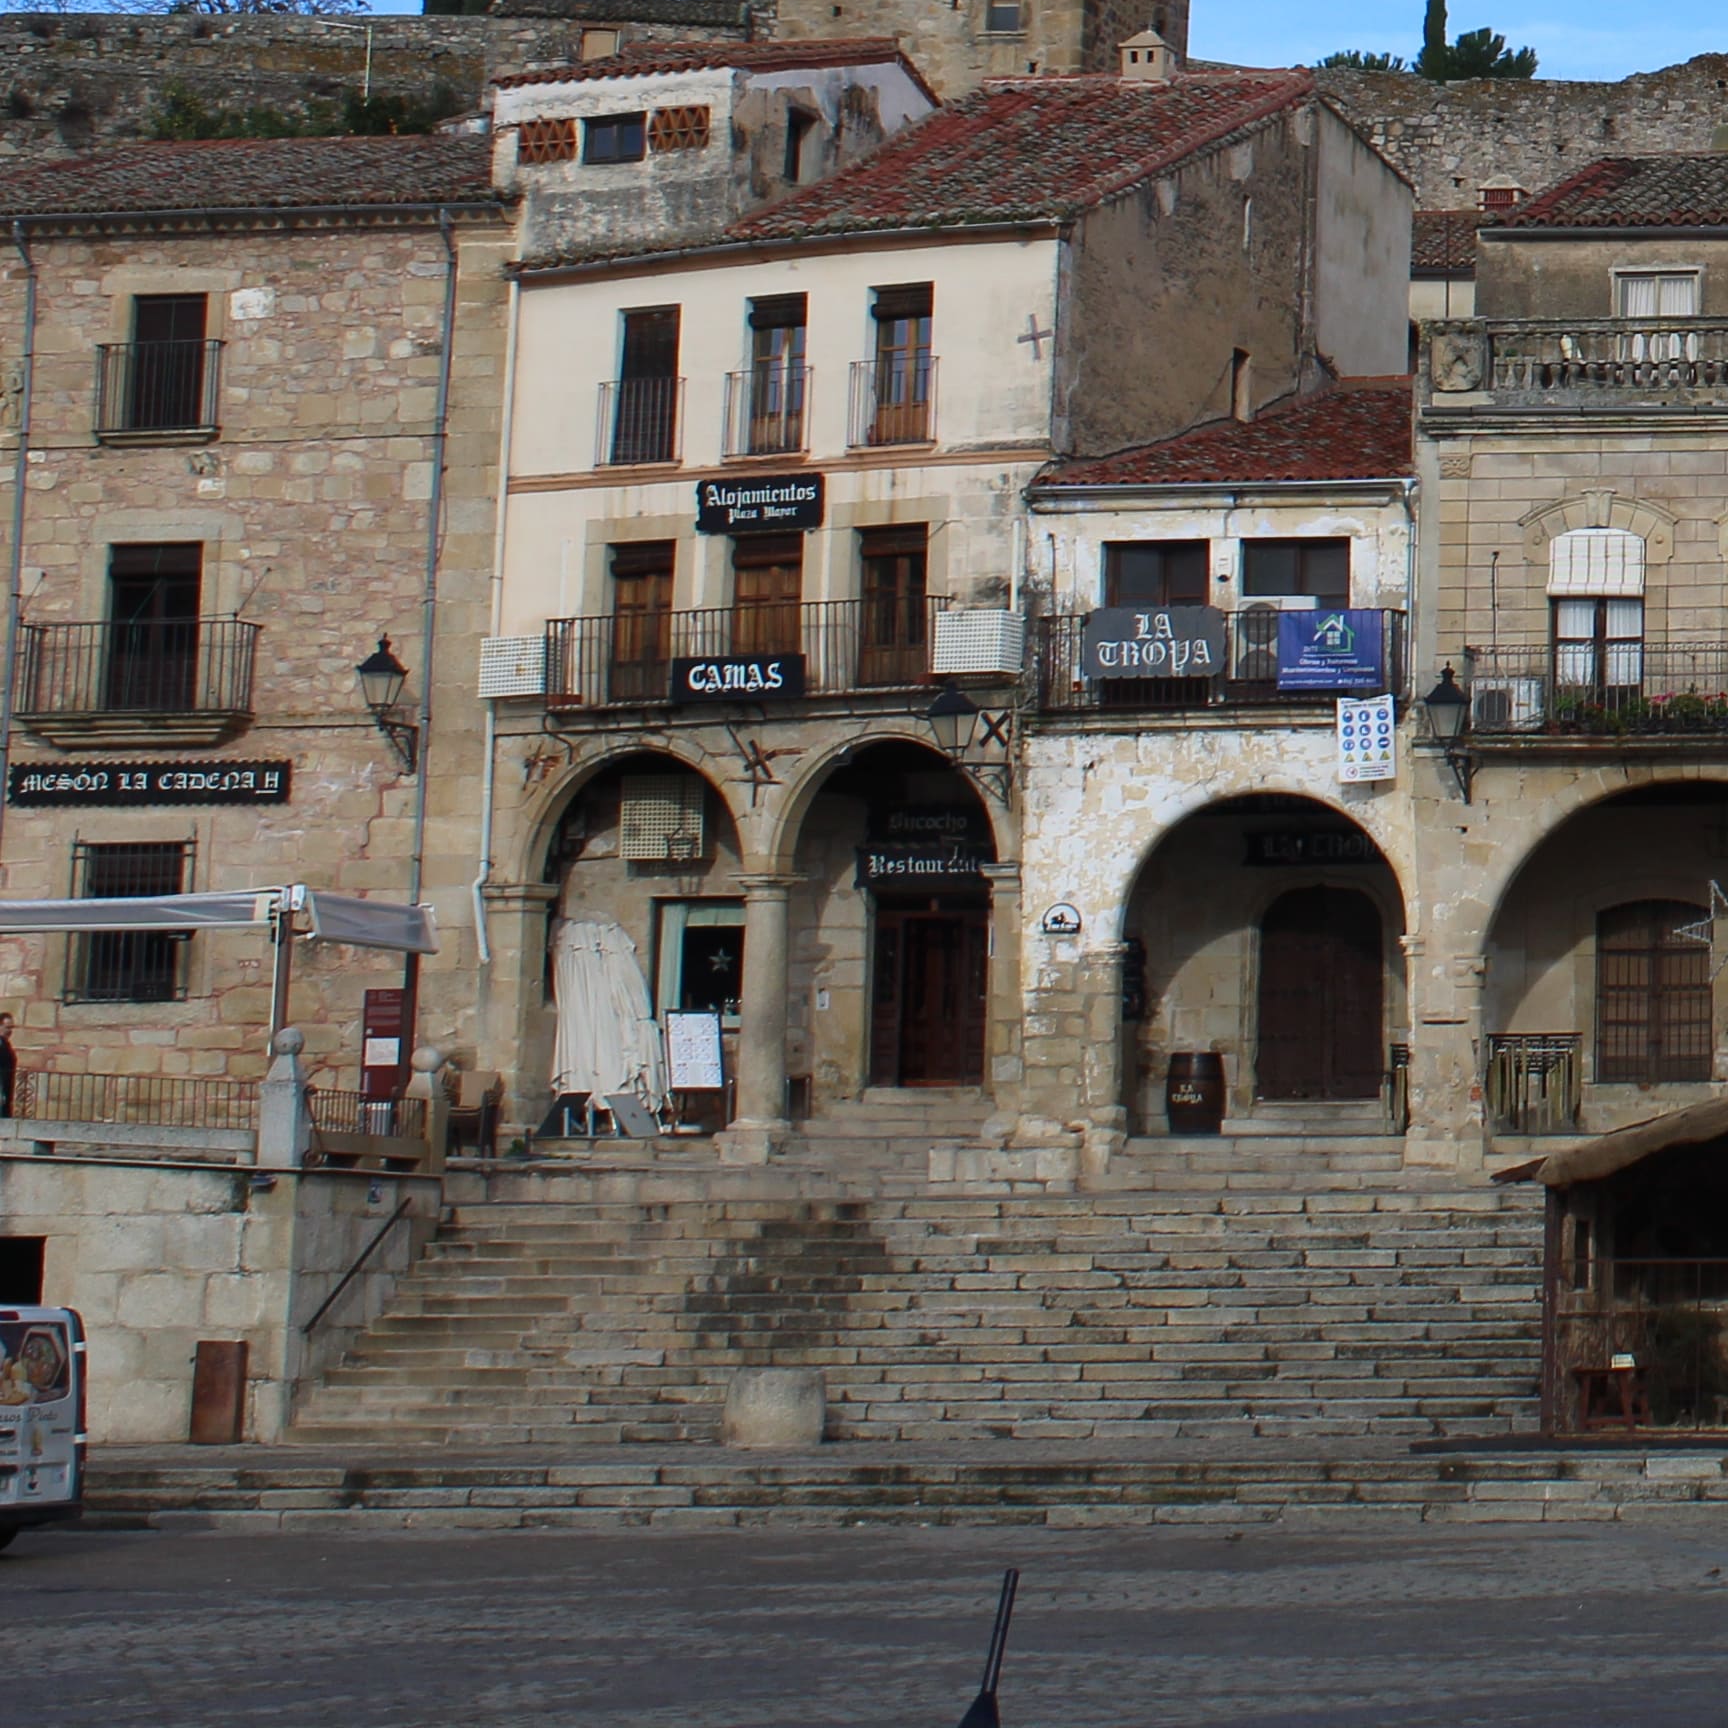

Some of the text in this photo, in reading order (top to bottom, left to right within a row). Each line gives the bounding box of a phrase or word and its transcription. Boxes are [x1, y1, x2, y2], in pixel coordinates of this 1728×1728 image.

[706, 483, 817, 508] Alojamientos
[728, 506, 798, 523] Plaza Mayor
[1134, 613, 1174, 640] LA
[1097, 639, 1211, 675] TROYA
[688, 662, 783, 692] CAMAS
[20, 768, 108, 793] MESÓN
[118, 771, 148, 791] LA
[158, 771, 255, 791] CADENA
